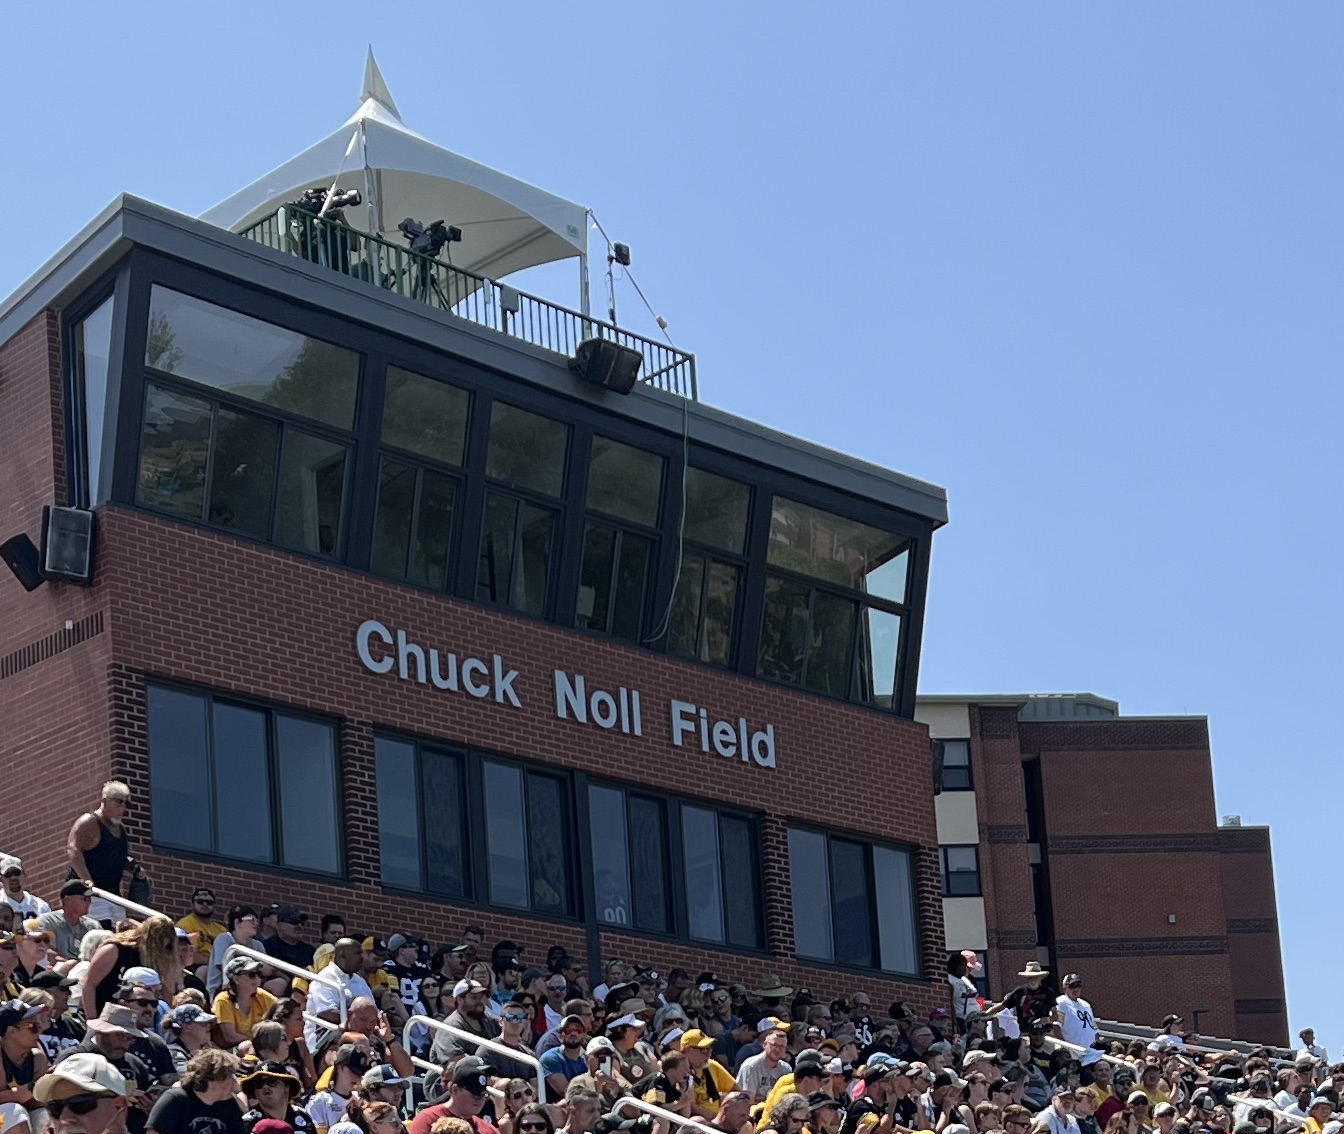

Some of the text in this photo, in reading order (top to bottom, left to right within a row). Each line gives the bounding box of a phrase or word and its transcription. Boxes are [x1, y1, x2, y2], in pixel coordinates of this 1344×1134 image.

[356, 619, 777, 769] Chuck Noll Field
